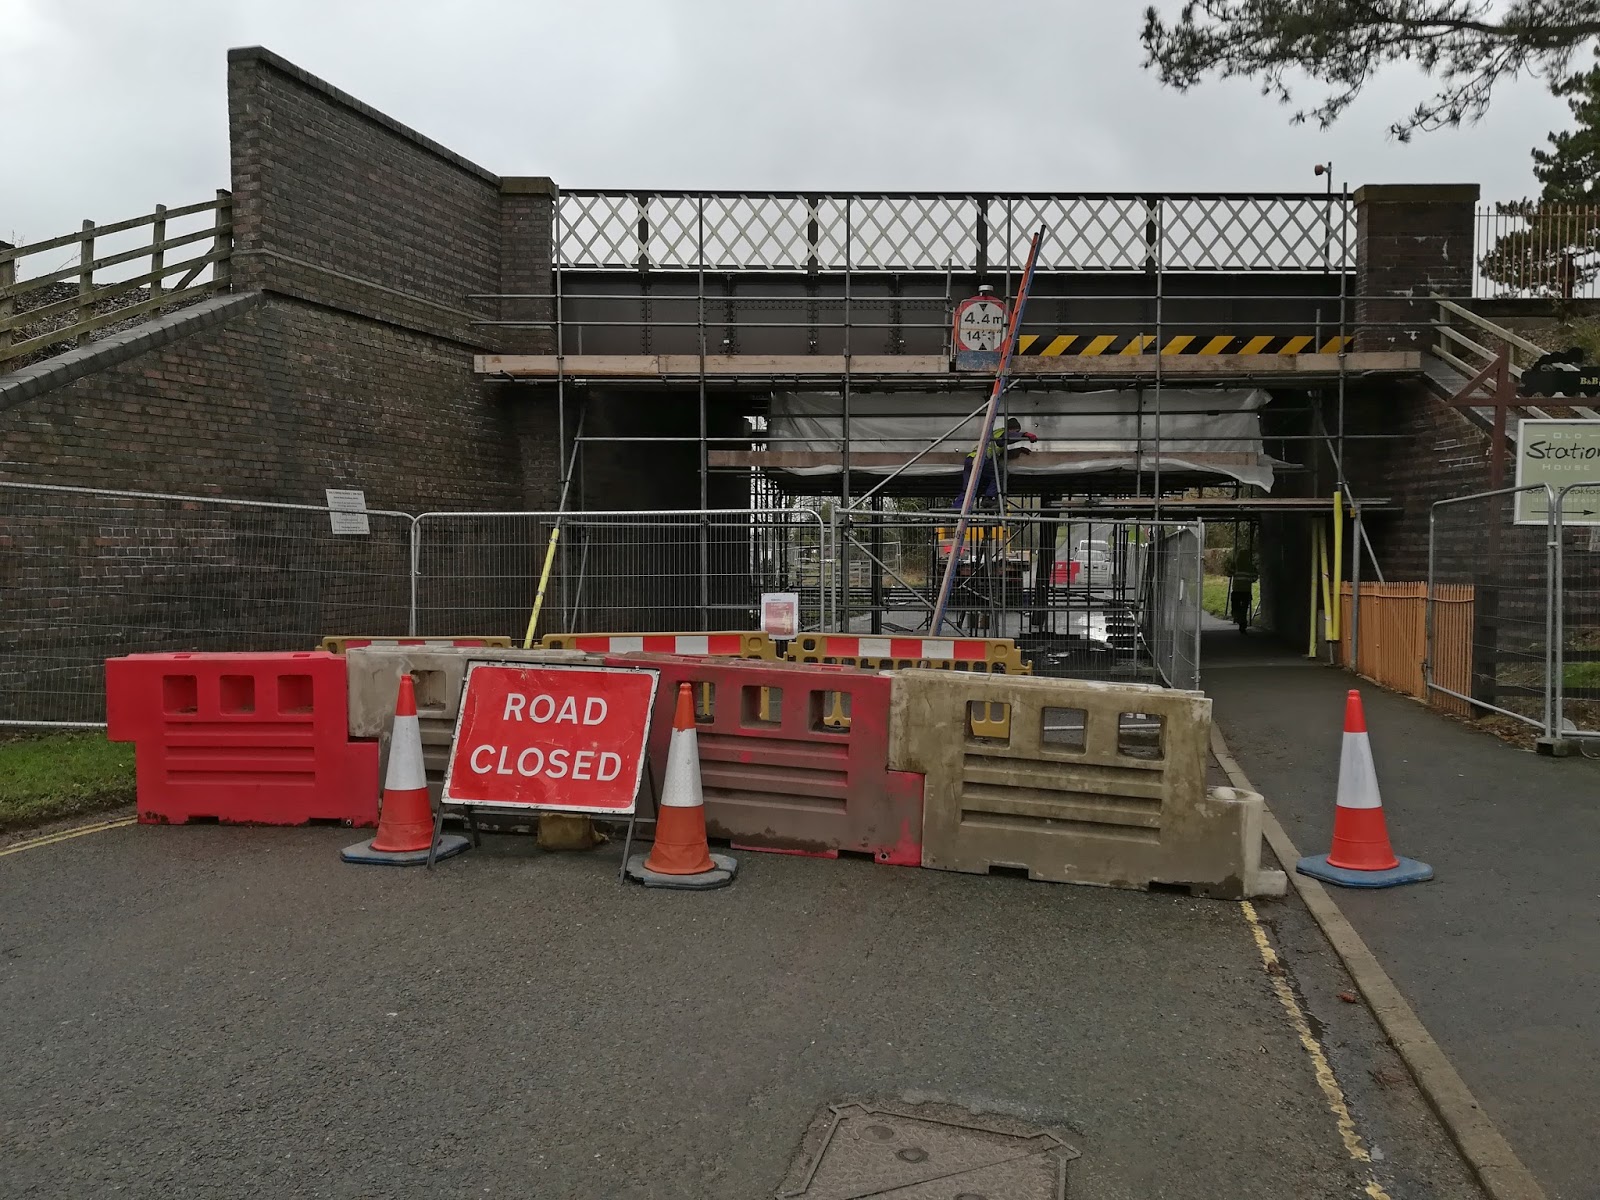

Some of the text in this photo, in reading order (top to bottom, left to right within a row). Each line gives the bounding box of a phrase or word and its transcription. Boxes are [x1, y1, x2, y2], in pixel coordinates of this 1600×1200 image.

[1525, 440, 1600, 460] Statio
[503, 692, 608, 726] ROAD
[469, 744, 622, 782] CLOSED
